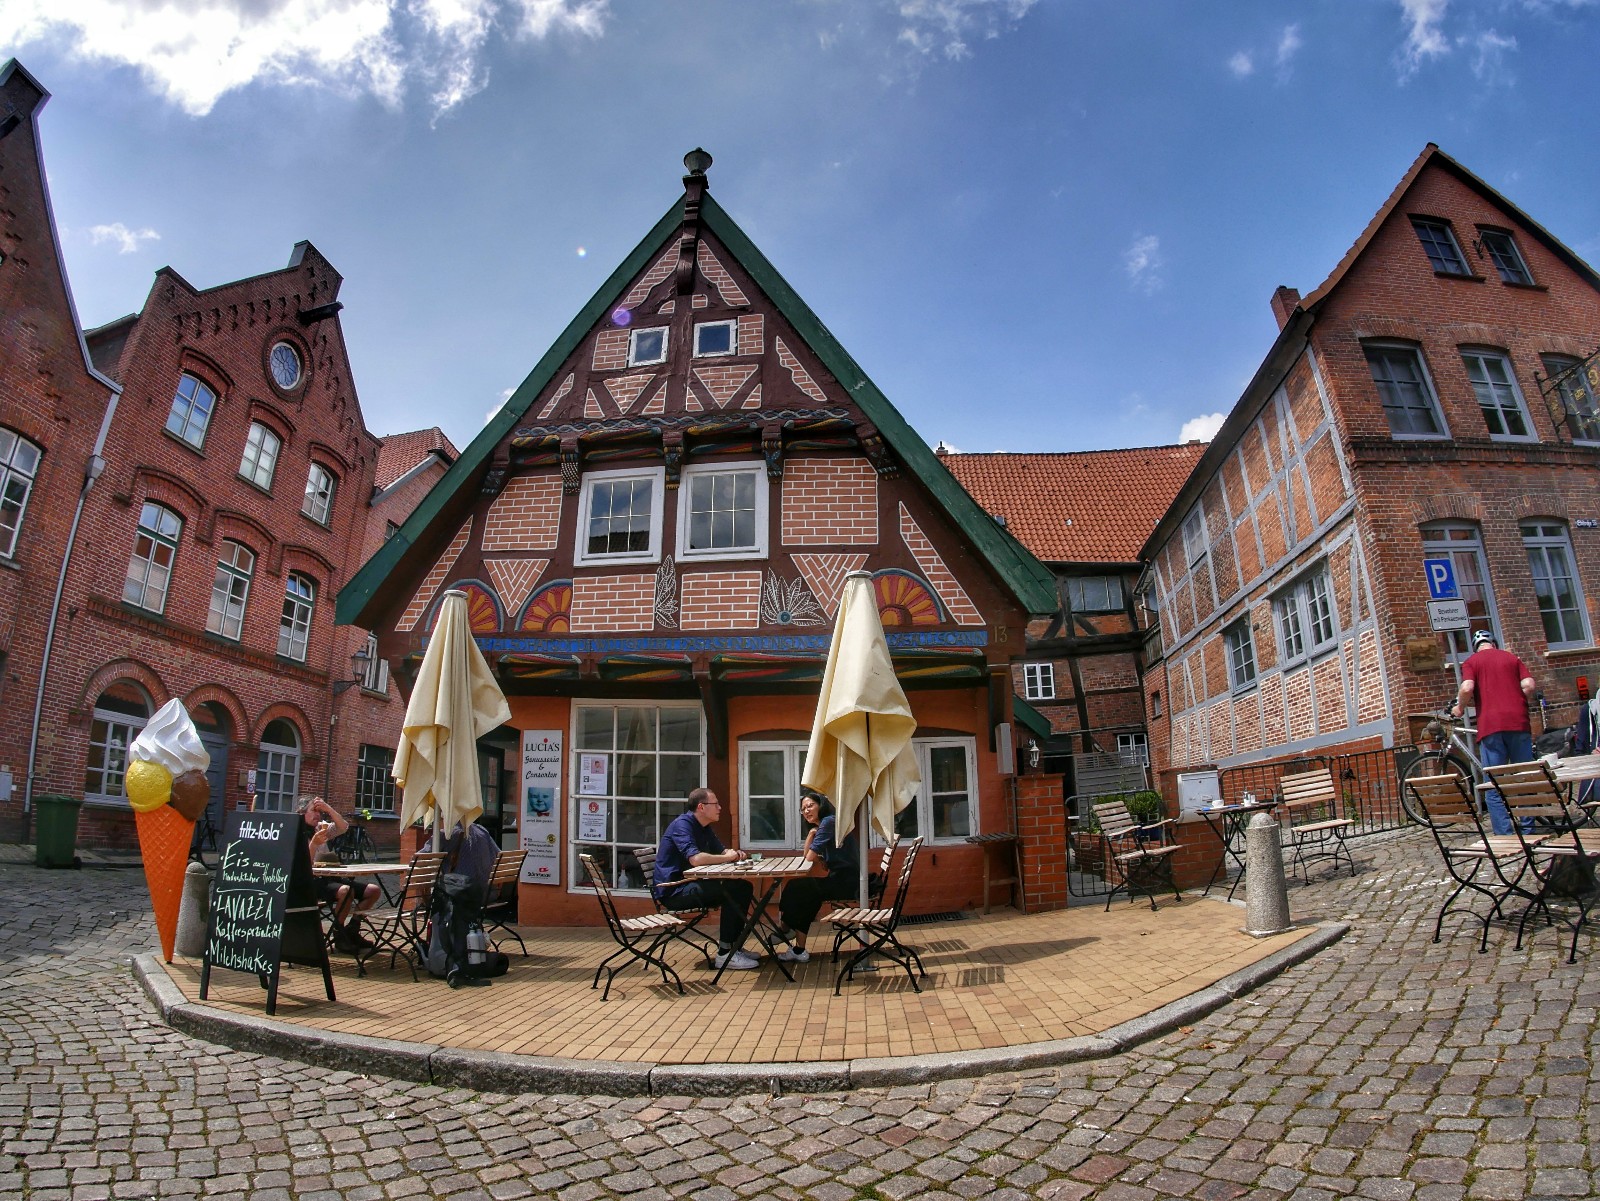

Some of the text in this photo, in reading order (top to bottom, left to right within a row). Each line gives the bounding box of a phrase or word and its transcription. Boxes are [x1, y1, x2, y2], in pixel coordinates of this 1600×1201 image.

[1431, 564, 1448, 594] P
[525, 742, 560, 752] LUCIA'S
[223, 839, 250, 870] Eis
[216, 894, 273, 923] LAVAZZA
